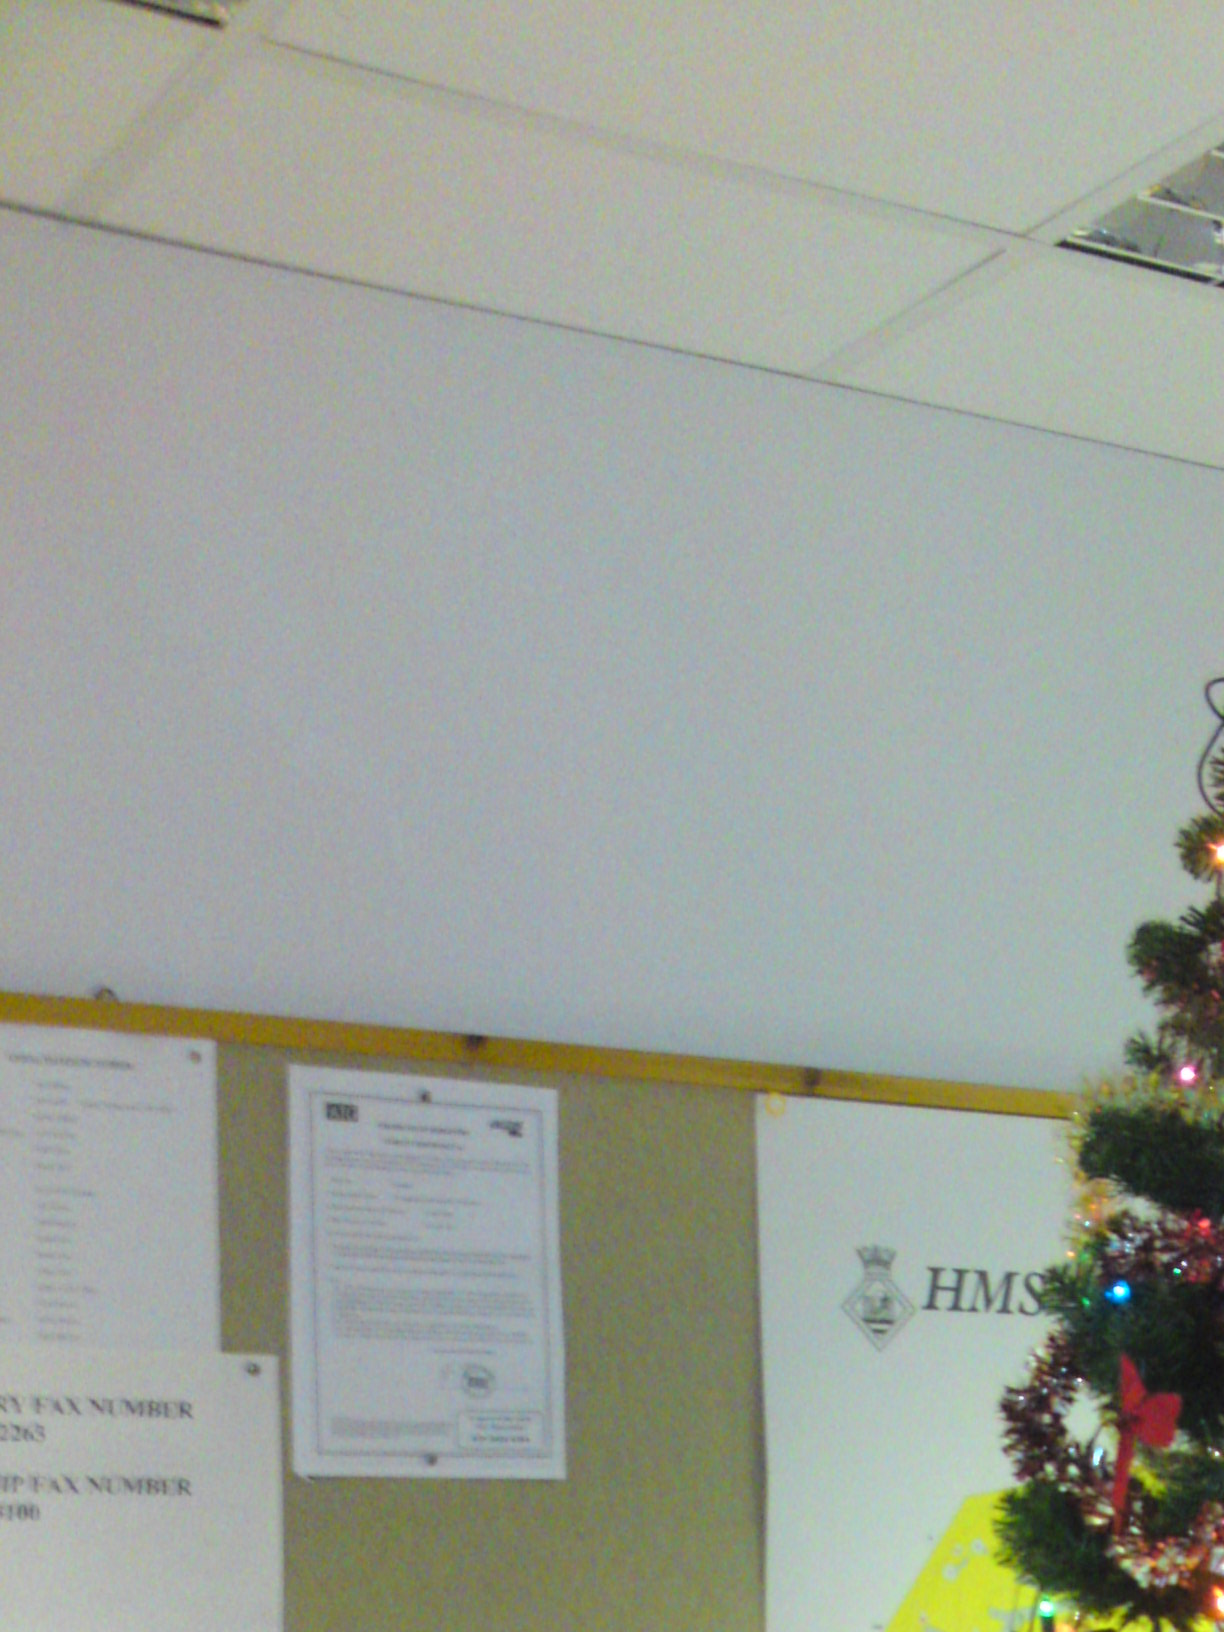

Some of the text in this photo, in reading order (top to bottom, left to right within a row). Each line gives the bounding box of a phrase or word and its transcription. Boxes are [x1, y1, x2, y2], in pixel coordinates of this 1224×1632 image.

[921, 1266, 1044, 1316] HMS
[32, 1396, 81, 1415] FAX
[86, 1397, 194, 1420] NUMBER
[29, 1475, 80, 1494] FAX
[85, 1475, 192, 1497] NUMBER
[0, 1502, 41, 1521] 100
